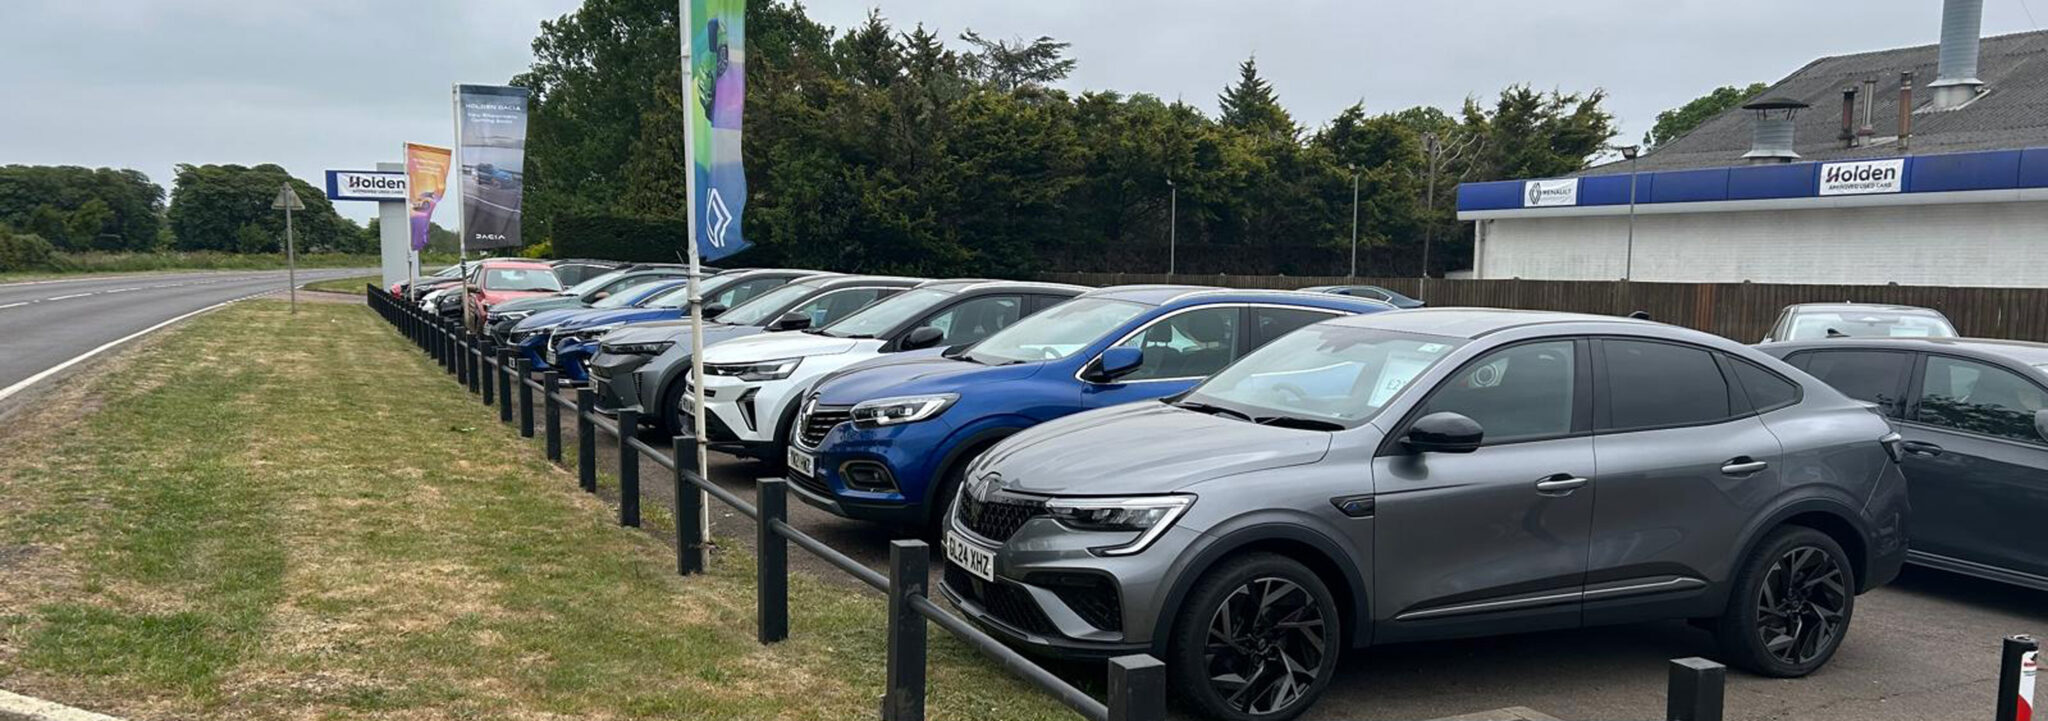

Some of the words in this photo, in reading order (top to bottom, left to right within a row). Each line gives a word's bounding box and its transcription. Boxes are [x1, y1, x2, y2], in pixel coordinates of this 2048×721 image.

[1826, 164, 1896, 183] Holden
[349, 176, 406, 189] Holden
[1542, 188, 1572, 196] RENAULT
[950, 537, 969, 566] GL24
[970, 549, 990, 577] XHZ
